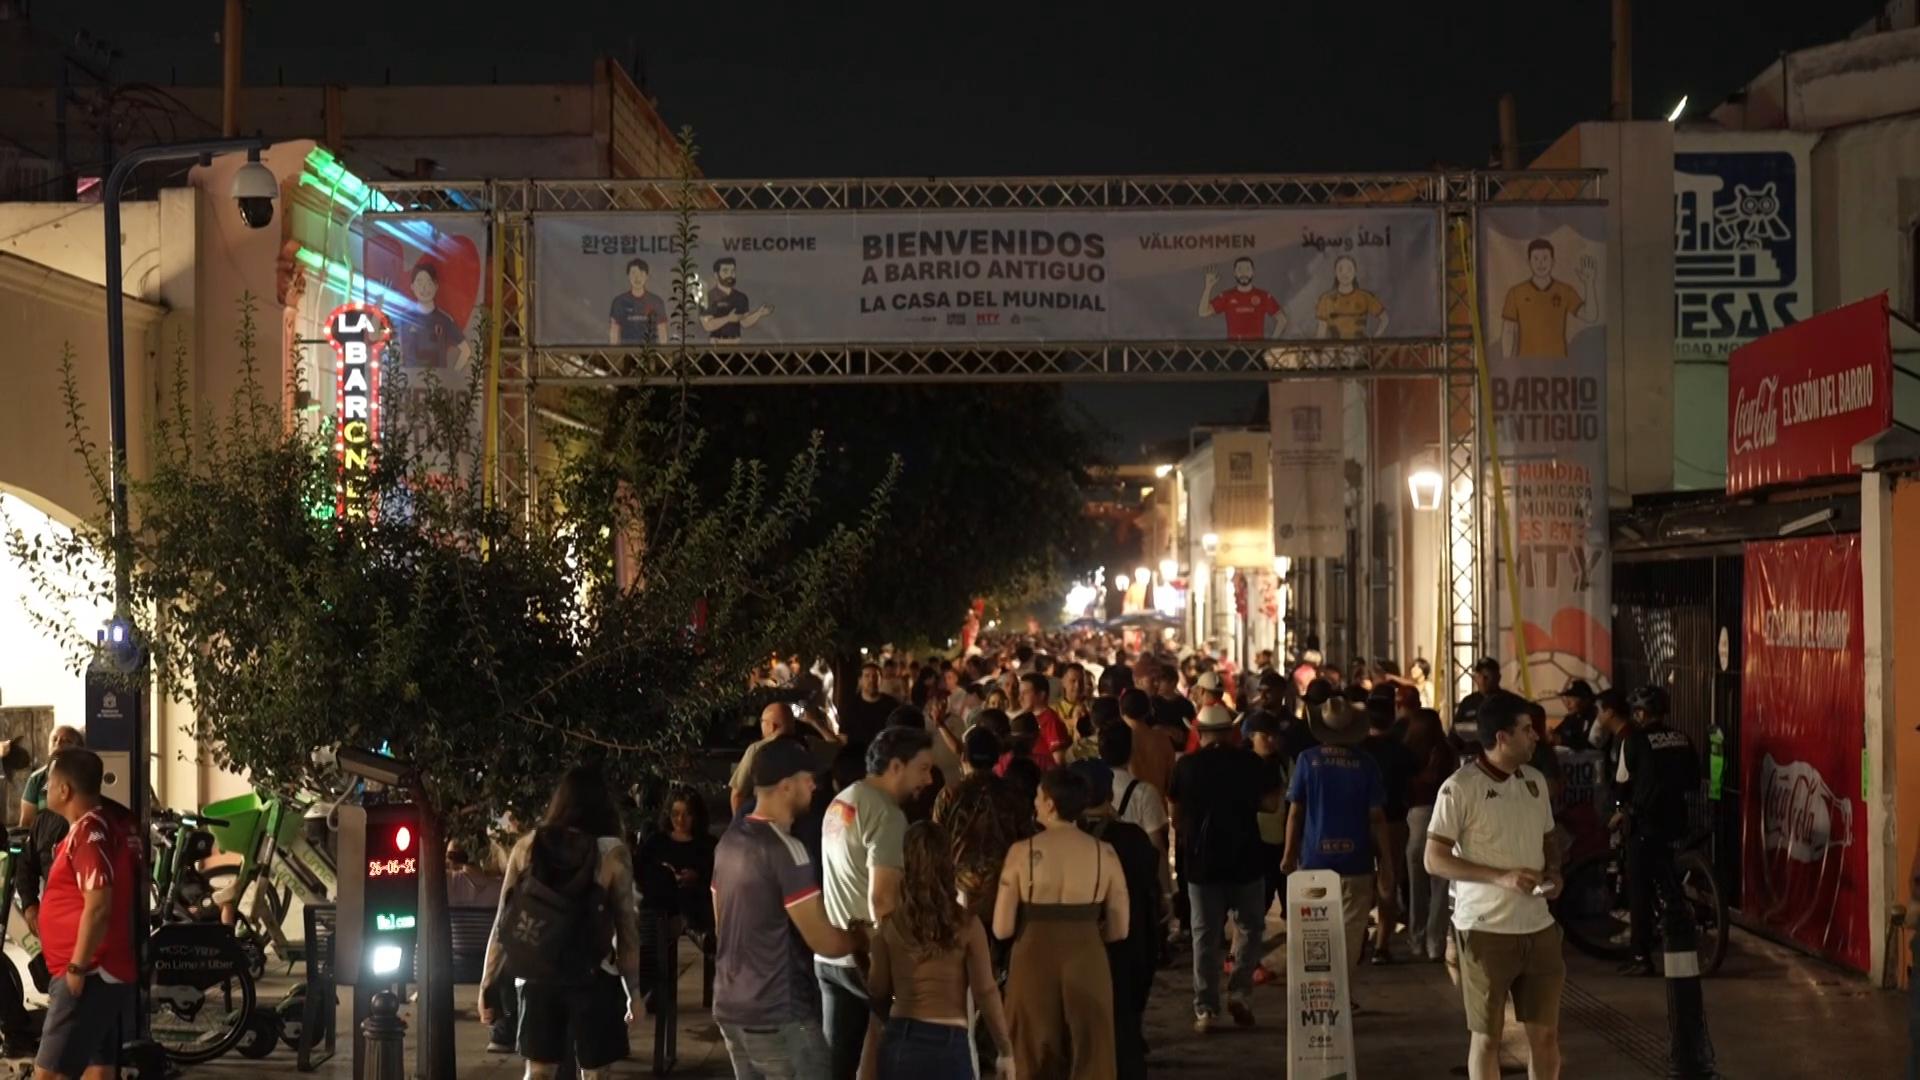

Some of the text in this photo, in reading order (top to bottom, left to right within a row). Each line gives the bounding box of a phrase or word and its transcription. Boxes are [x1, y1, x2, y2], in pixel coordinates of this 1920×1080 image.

[723, 237, 816, 251] WELCOME
[863, 229, 1105, 260] BIENVENIDOS
[1139, 232, 1256, 250] VÄLKOMMEN
[862, 260, 1105, 285] A BARRIO ANTIGUO
[861, 291, 1106, 313] LA CASA DEL MUNDIAL
[338, 314, 375, 333] LA
[1675, 292, 1798, 338] ESAS
[1491, 376, 1598, 411] BARRIO
[1782, 363, 1874, 427] EL SAZÓN DEL BARRIO
[1301, 905, 1328, 917] MTY
[1302, 1009, 1340, 1027] MTY
